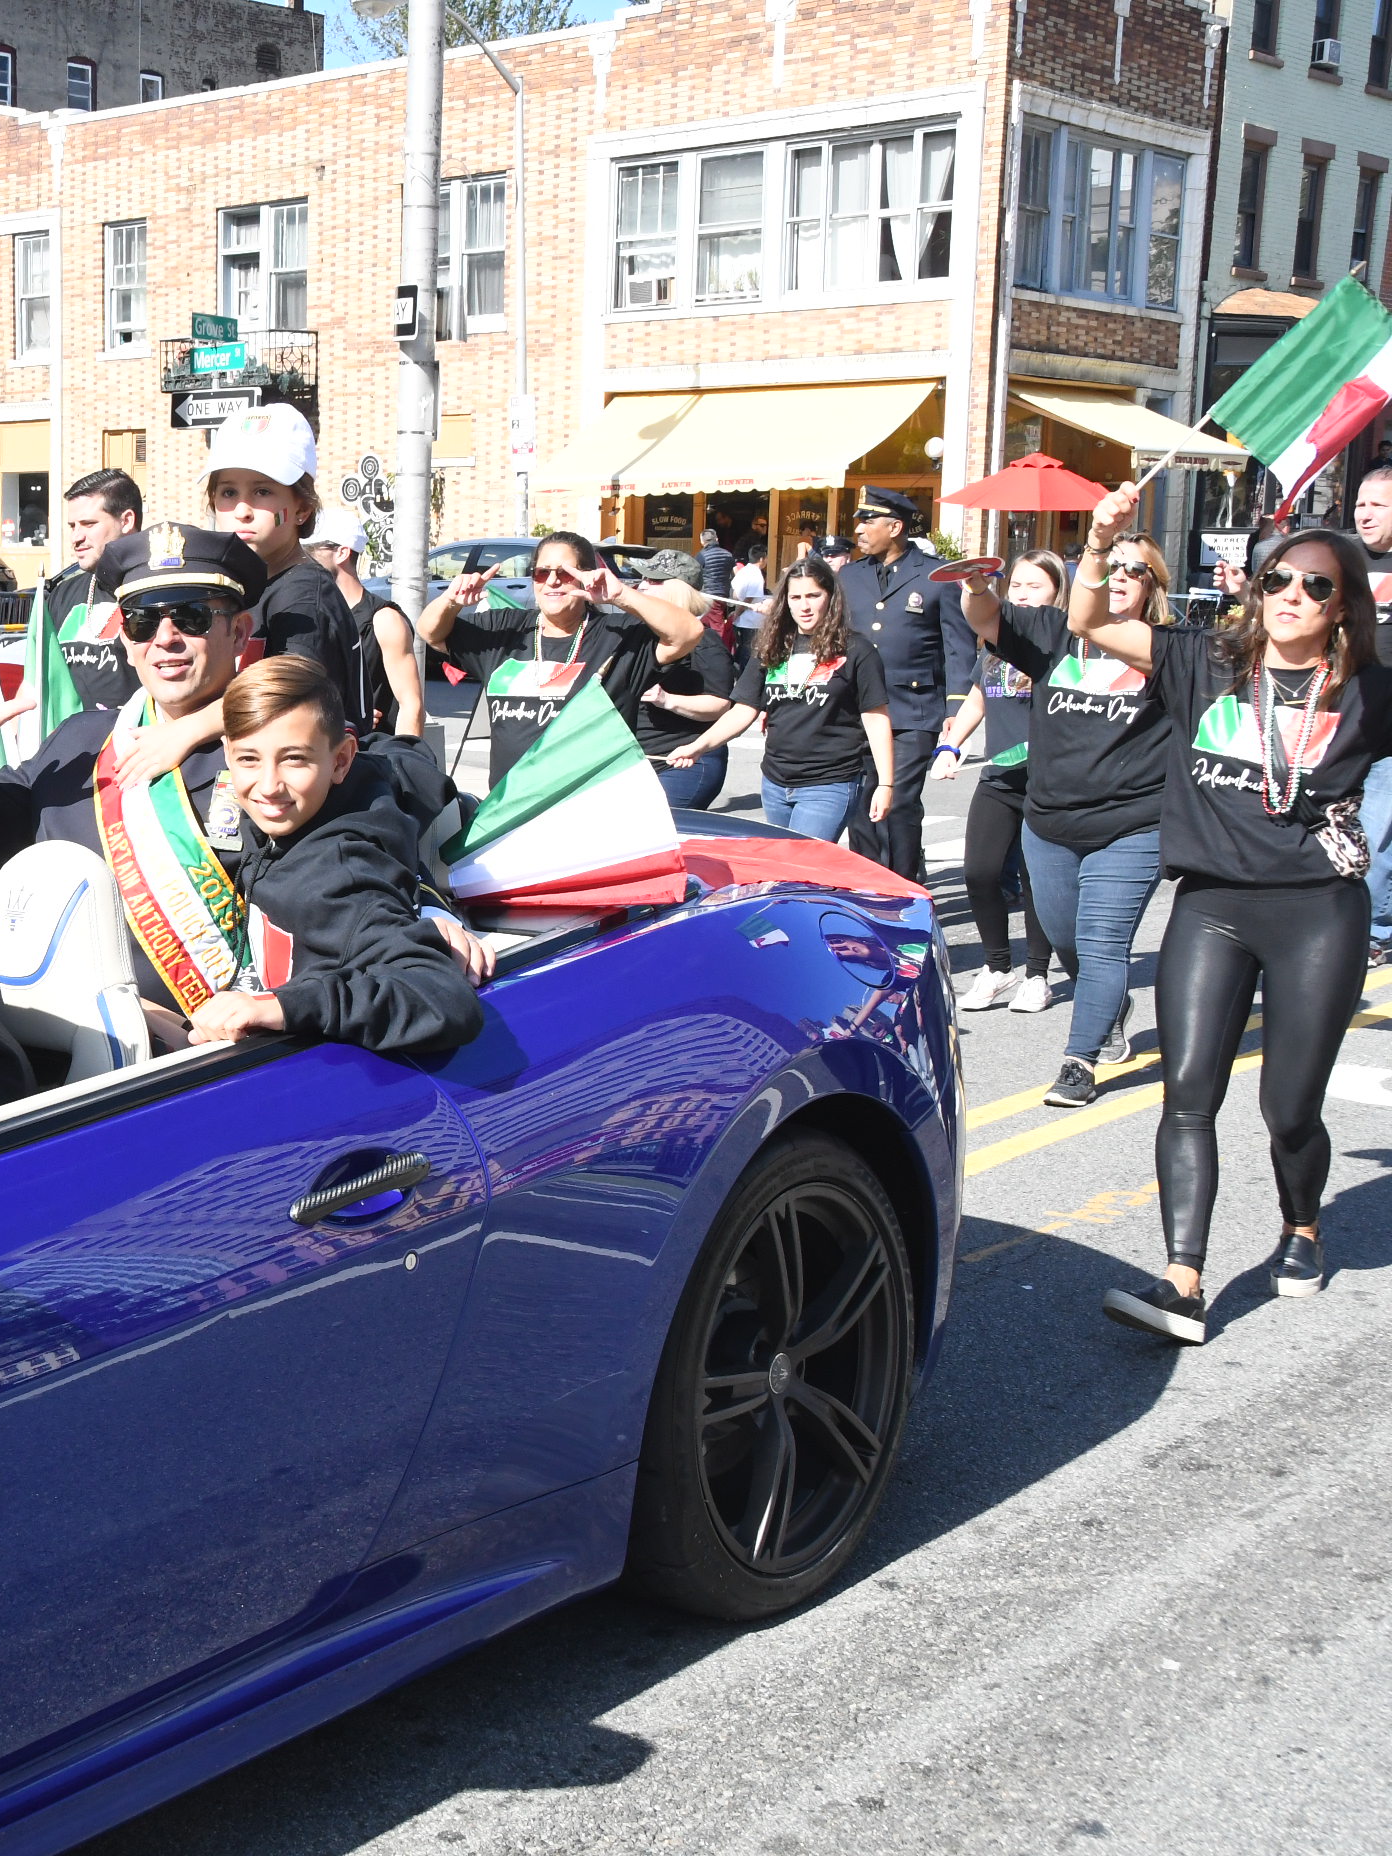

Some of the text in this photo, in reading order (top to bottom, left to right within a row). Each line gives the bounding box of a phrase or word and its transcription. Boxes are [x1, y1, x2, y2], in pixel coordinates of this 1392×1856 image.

[195, 317, 225, 338] Grove
[194, 351, 231, 369] Mercer
[187, 401, 243, 416] ONE WAY
[805, 686, 829, 707] Day
[1047, 691, 1140, 725] Columbus Day
[537, 702, 561, 727] Da
[1192, 758, 1270, 793] Columbu
[107, 820, 141, 890] CAPTAIN
[128, 892, 186, 970] ANTHONY
[160, 879, 210, 946] POLICE
